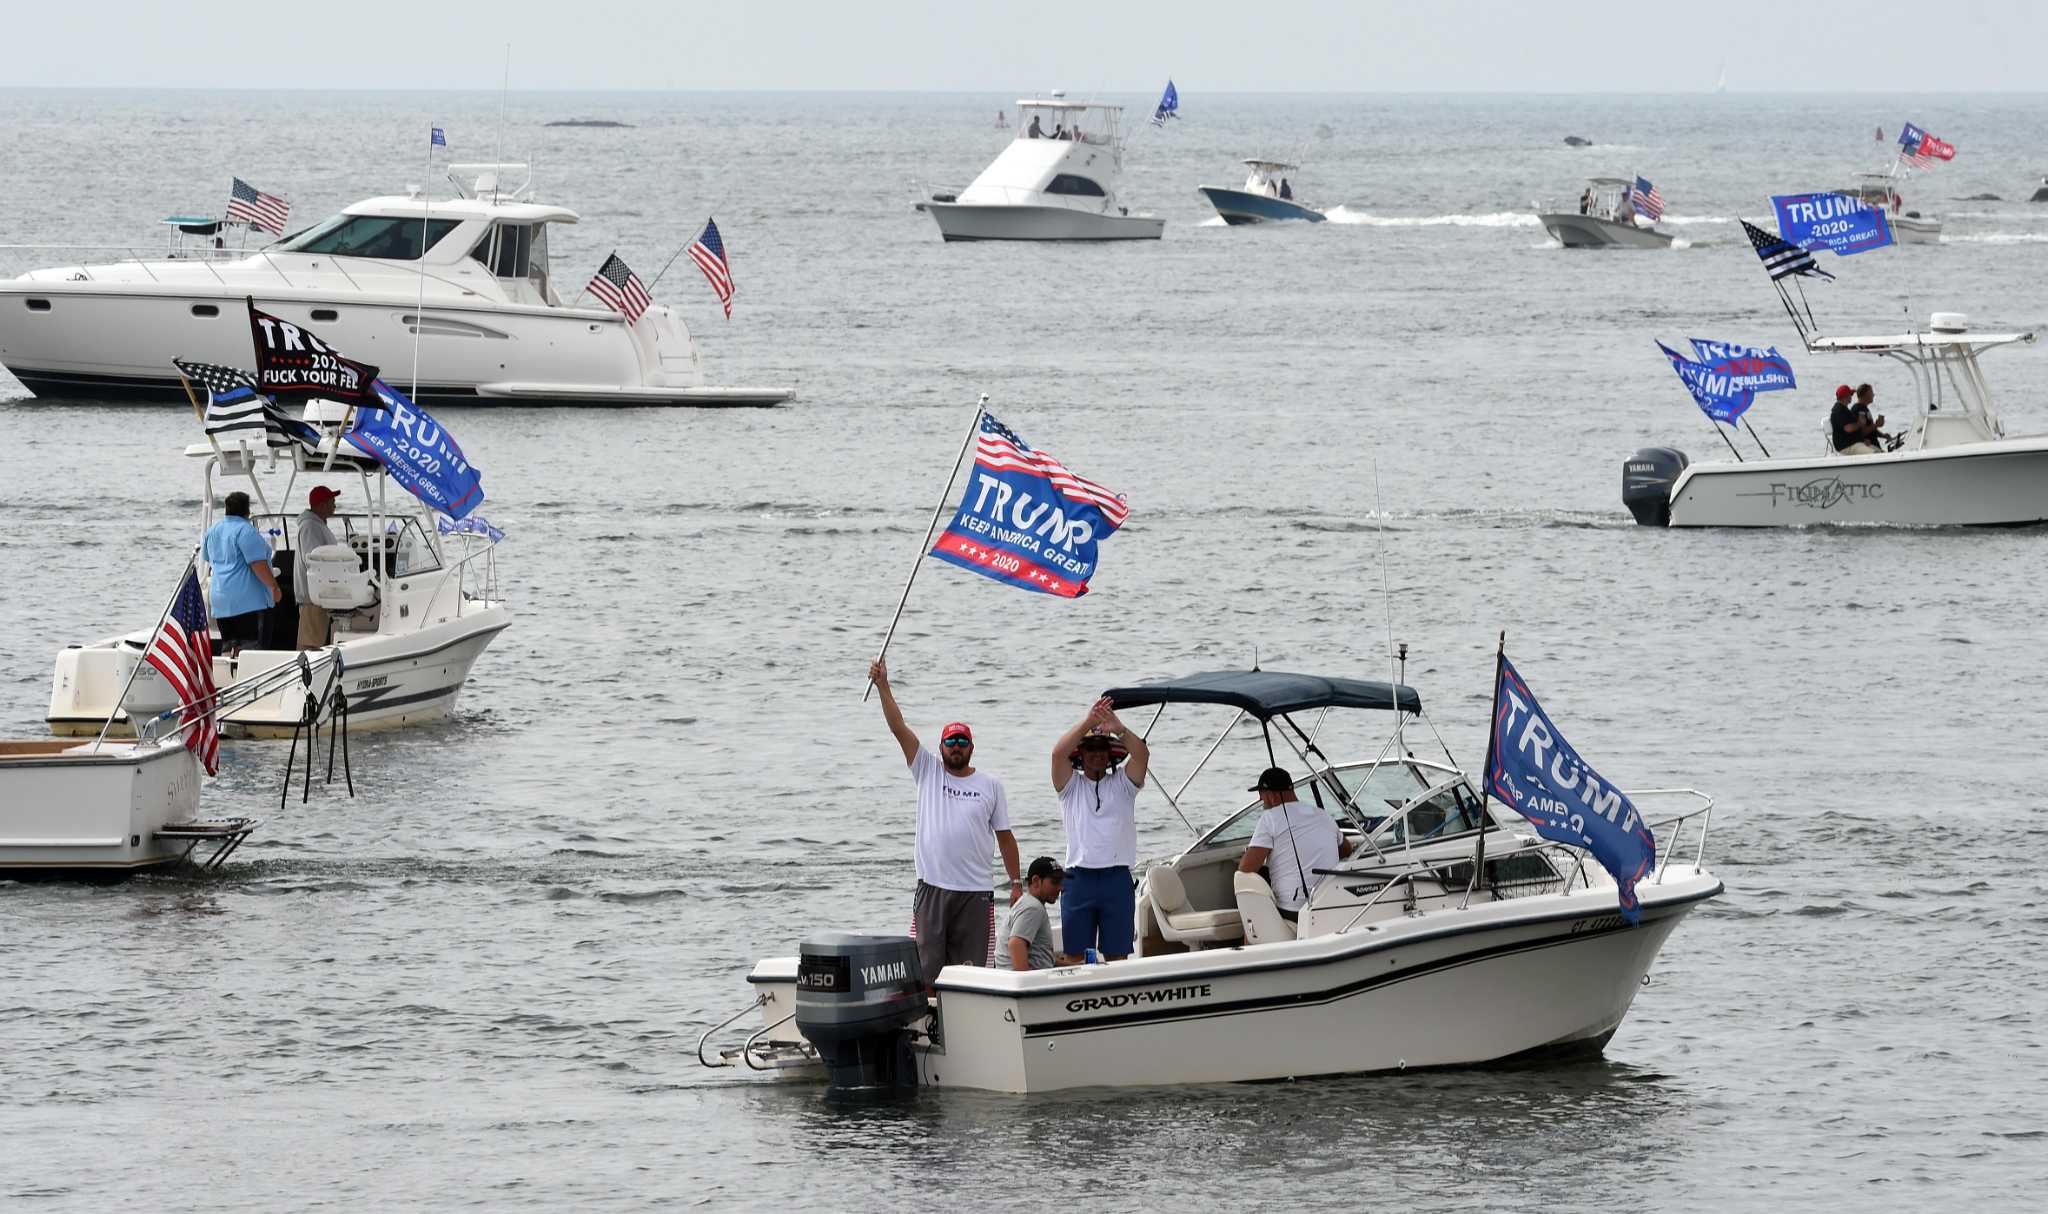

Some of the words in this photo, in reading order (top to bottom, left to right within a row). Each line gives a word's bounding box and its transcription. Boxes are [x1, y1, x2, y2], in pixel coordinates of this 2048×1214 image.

[263, 369, 297, 384] FUCK
[300, 370, 337, 386] YOUR
[1629, 463, 1655, 473] YAMAHA
[960, 512, 990, 536] KEEP
[973, 473, 1093, 556] TRUMP
[991, 552, 1020, 574] 2020
[943, 785, 981, 798] TRUMP
[809, 973, 835, 987] 150
[860, 961, 907, 985] YAMAHA
[1065, 984, 1212, 1013] GRADY-WHITE
